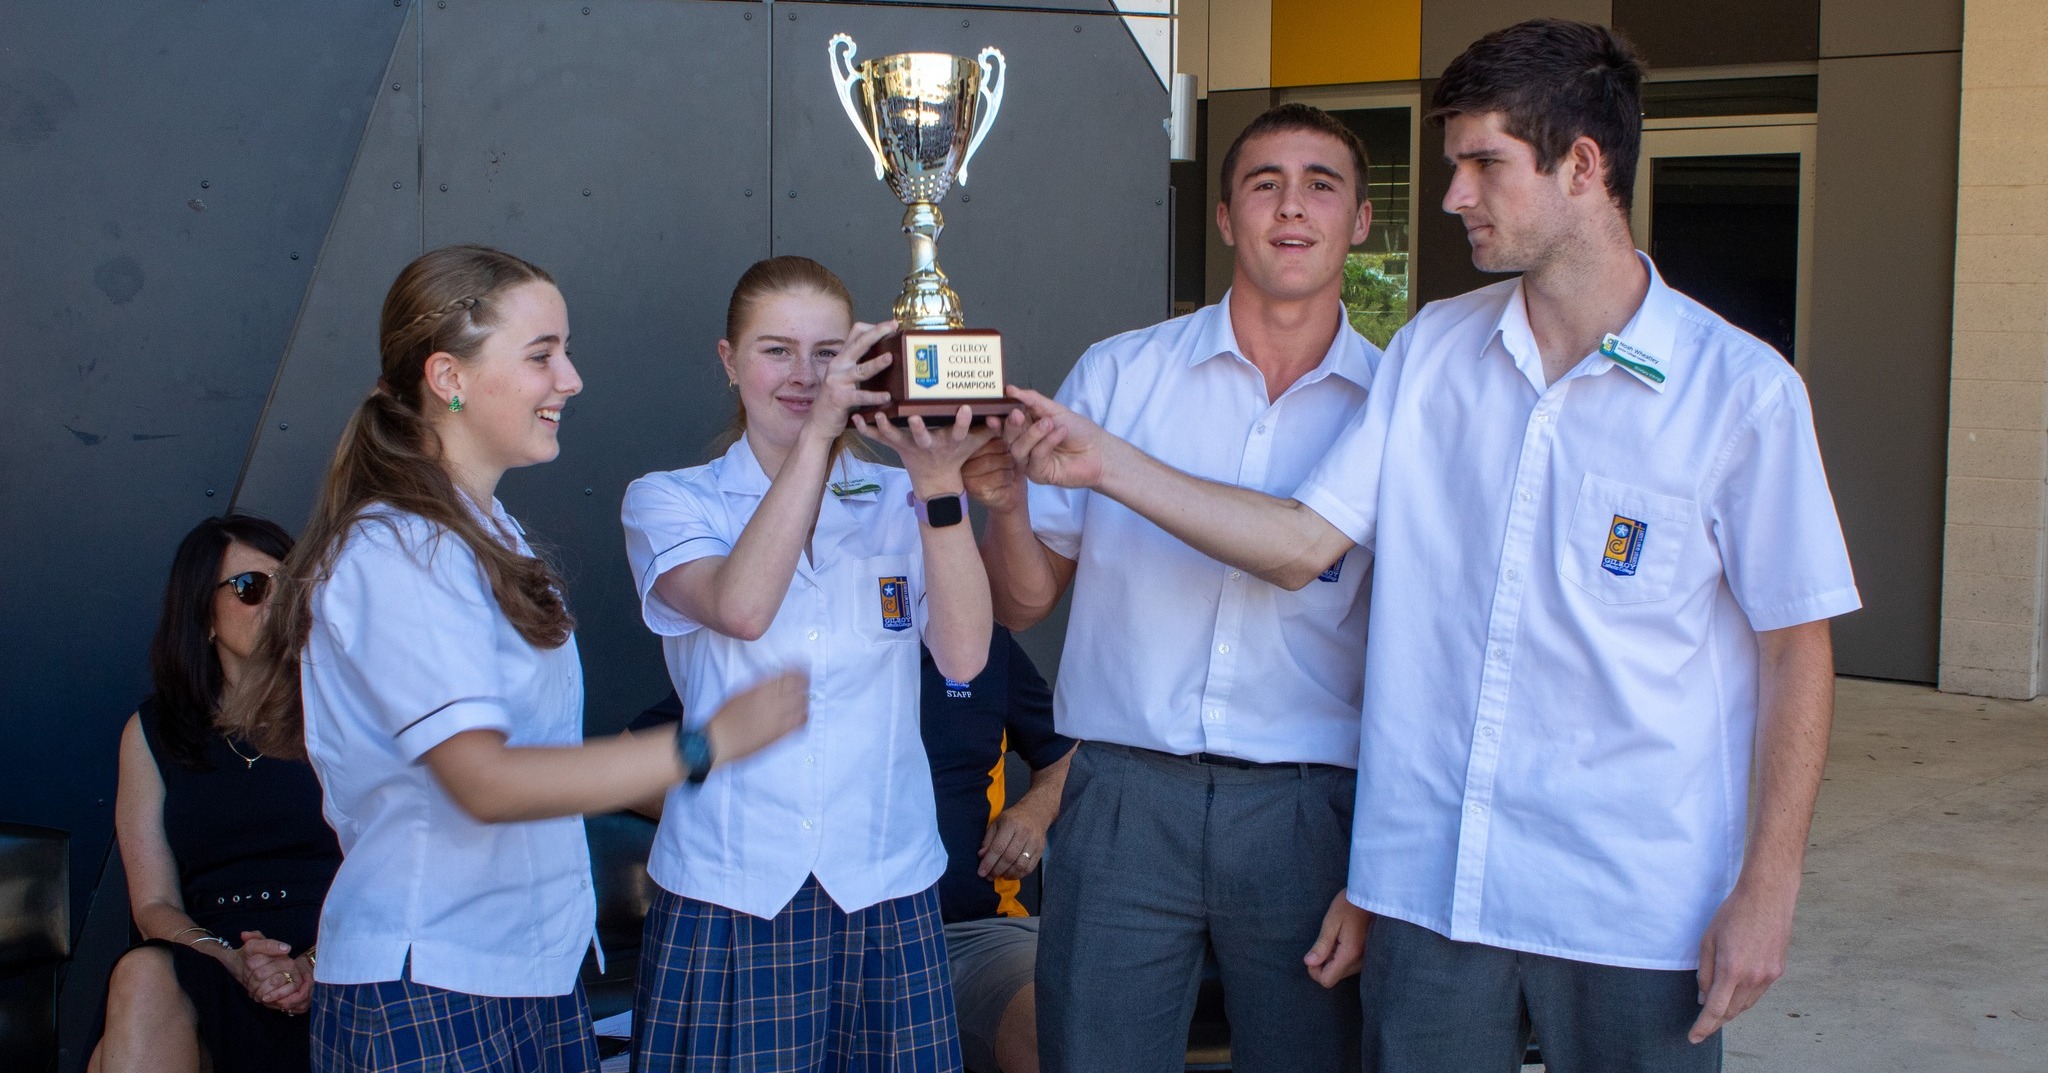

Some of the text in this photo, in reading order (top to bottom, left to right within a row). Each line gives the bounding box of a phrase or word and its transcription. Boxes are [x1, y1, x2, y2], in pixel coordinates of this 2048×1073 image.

[951, 343, 988, 352] GILROY
[1619, 341, 1660, 365] Noah Wheatley
[948, 355, 992, 364] COLLEGE
[946, 370, 994, 378] HOUSE CUP
[946, 381, 996, 390] CHAMPIONS
[1604, 557, 1637, 570] GILROY
[946, 689, 972, 698] STAFF
